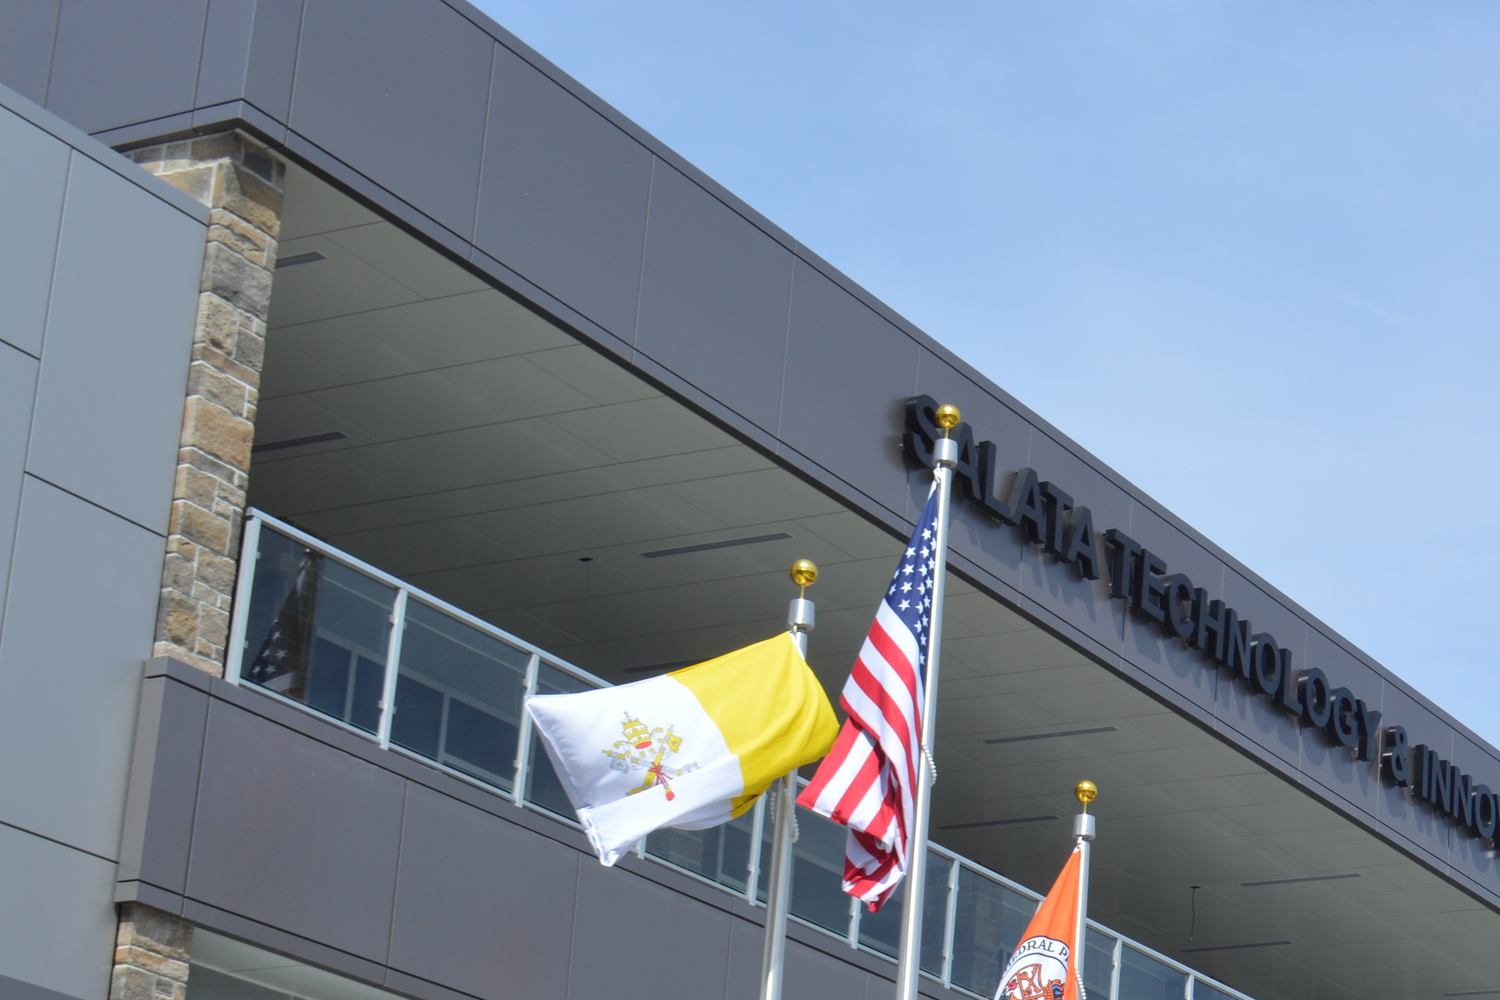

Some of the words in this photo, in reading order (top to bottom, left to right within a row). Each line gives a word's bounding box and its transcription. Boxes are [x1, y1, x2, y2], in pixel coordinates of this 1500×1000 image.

[903, 394, 1099, 581] SALATA
[1105, 528, 1383, 762] TECHNOLOGY
[1382, 725, 1410, 787] &
